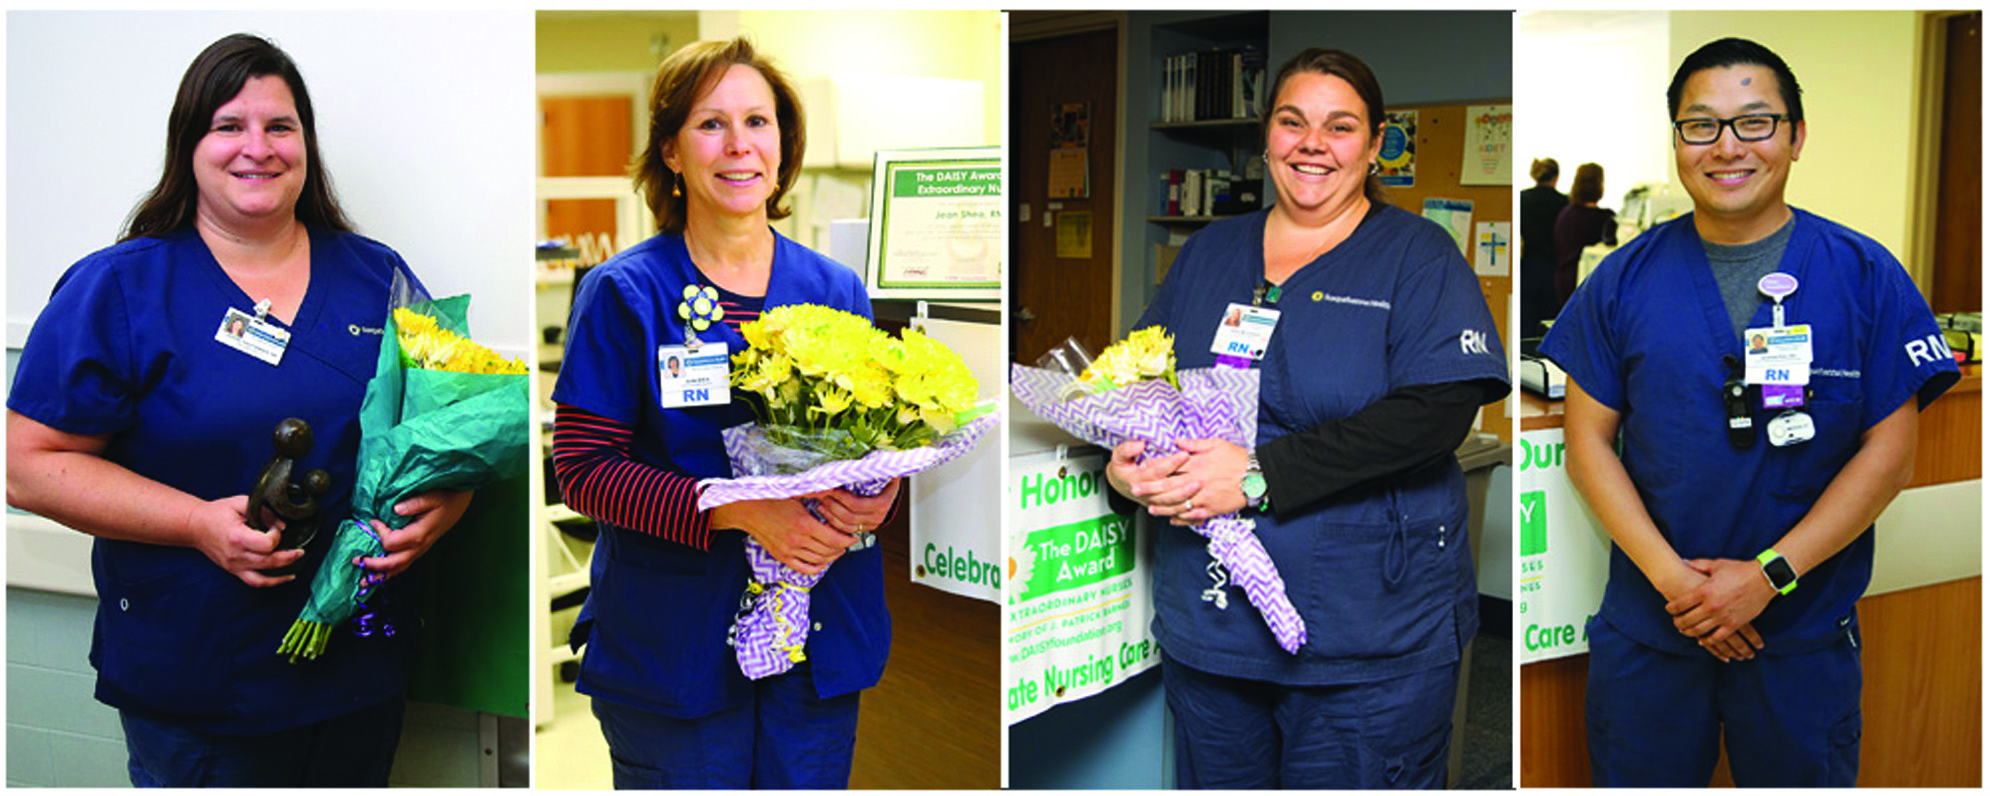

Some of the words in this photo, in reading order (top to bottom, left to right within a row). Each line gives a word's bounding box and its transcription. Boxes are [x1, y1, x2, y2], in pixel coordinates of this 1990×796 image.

[916, 172, 934, 182] The
[936, 171, 968, 182] DAISY
[918, 184, 985, 196] Extraordinary
[1227, 341, 1250, 354] RN
[1461, 329, 1490, 355] RN
[1904, 333, 1953, 367] RN
[1765, 368, 1790, 381] RN
[683, 388, 709, 403] RN
[1038, 539, 1071, 562] The
[1076, 518, 1130, 554] DAISY
[924, 542, 1001, 590] Celebra
[1056, 546, 1116, 582] Award
[1525, 623, 1575, 651] Care
[1044, 653, 1114, 698] Nursing
[1119, 638, 1150, 670] Care
